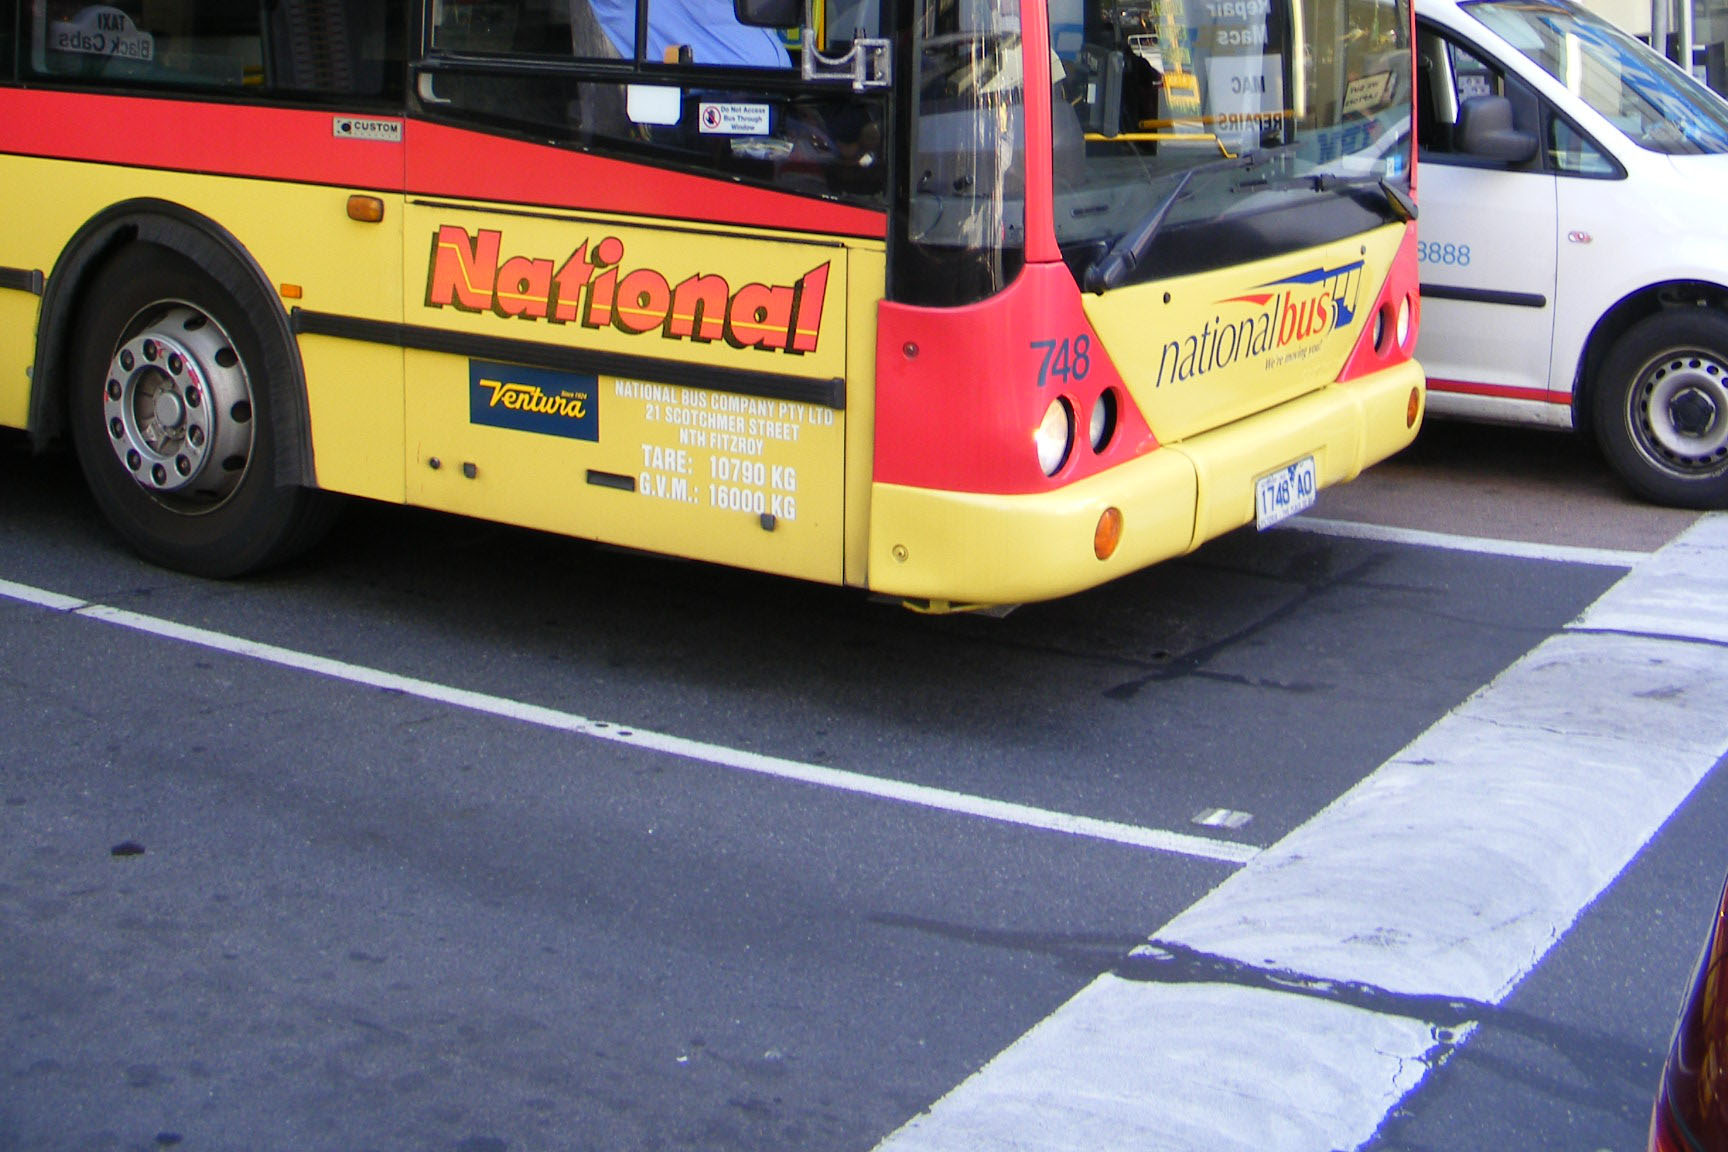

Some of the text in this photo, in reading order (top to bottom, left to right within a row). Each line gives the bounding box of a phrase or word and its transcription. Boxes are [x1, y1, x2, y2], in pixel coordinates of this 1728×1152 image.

[354, 121, 398, 133] CUSTOM
[424, 224, 831, 356] National
[1030, 334, 1091, 388] 748
[479, 378, 586, 419] Ventura
[615, 380, 834, 426] NATIONAL BUS COMPANY PTY LTD
[646, 404, 799, 441] 21 SCOTCHMER STREET
[680, 428, 763, 456] NTH FITZROY
[642, 443, 797, 492] TARE: 10790 KG
[708, 483, 766, 515] 16000
[771, 493, 797, 521] KG
[1262, 480, 1291, 515] 1748
